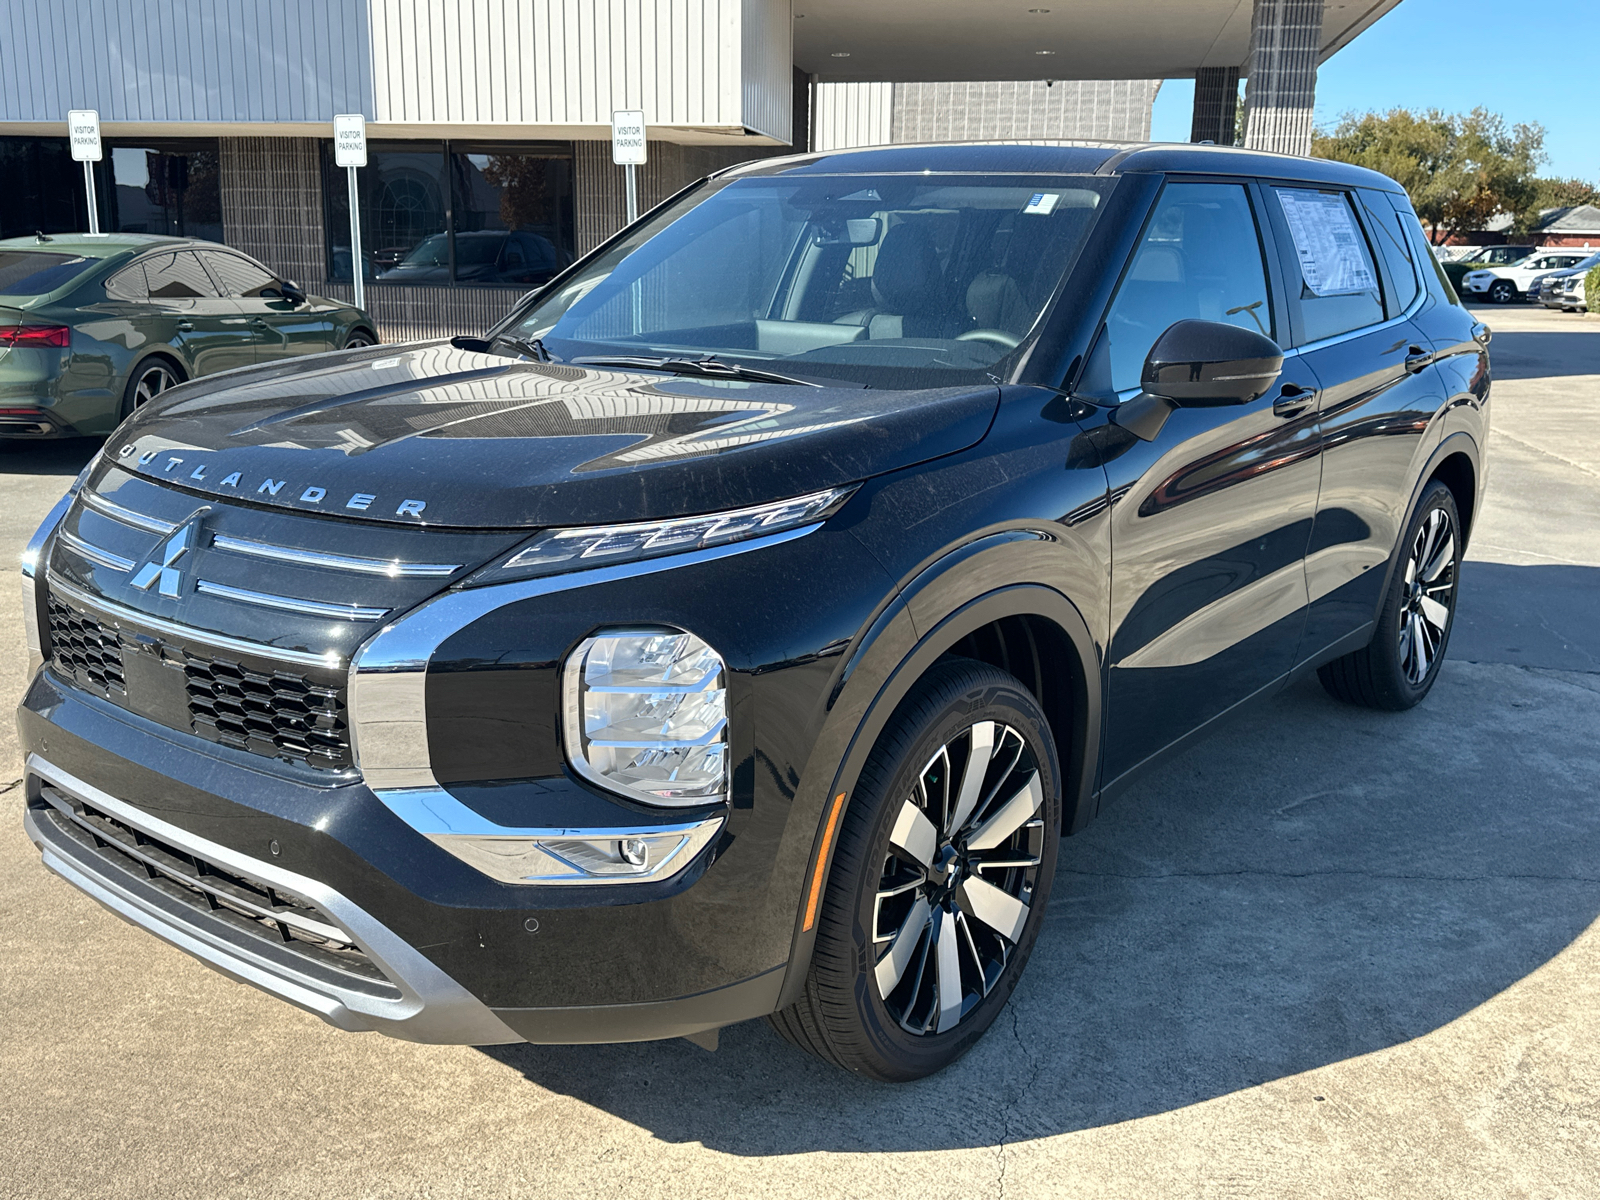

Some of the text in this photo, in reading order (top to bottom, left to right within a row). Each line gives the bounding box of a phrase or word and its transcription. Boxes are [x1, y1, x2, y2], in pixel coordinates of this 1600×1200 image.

[74, 126, 95, 134] VISITOR
[617, 127, 641, 135] VISITOR
[339, 131, 361, 139] VISITOR
[74, 137, 97, 145] PARKING
[617, 139, 642, 147] PARKING
[339, 142, 363, 150] PARKING
[119, 443, 428, 519] OUTLANDER
[865, 765, 912, 888] ROADIAN
